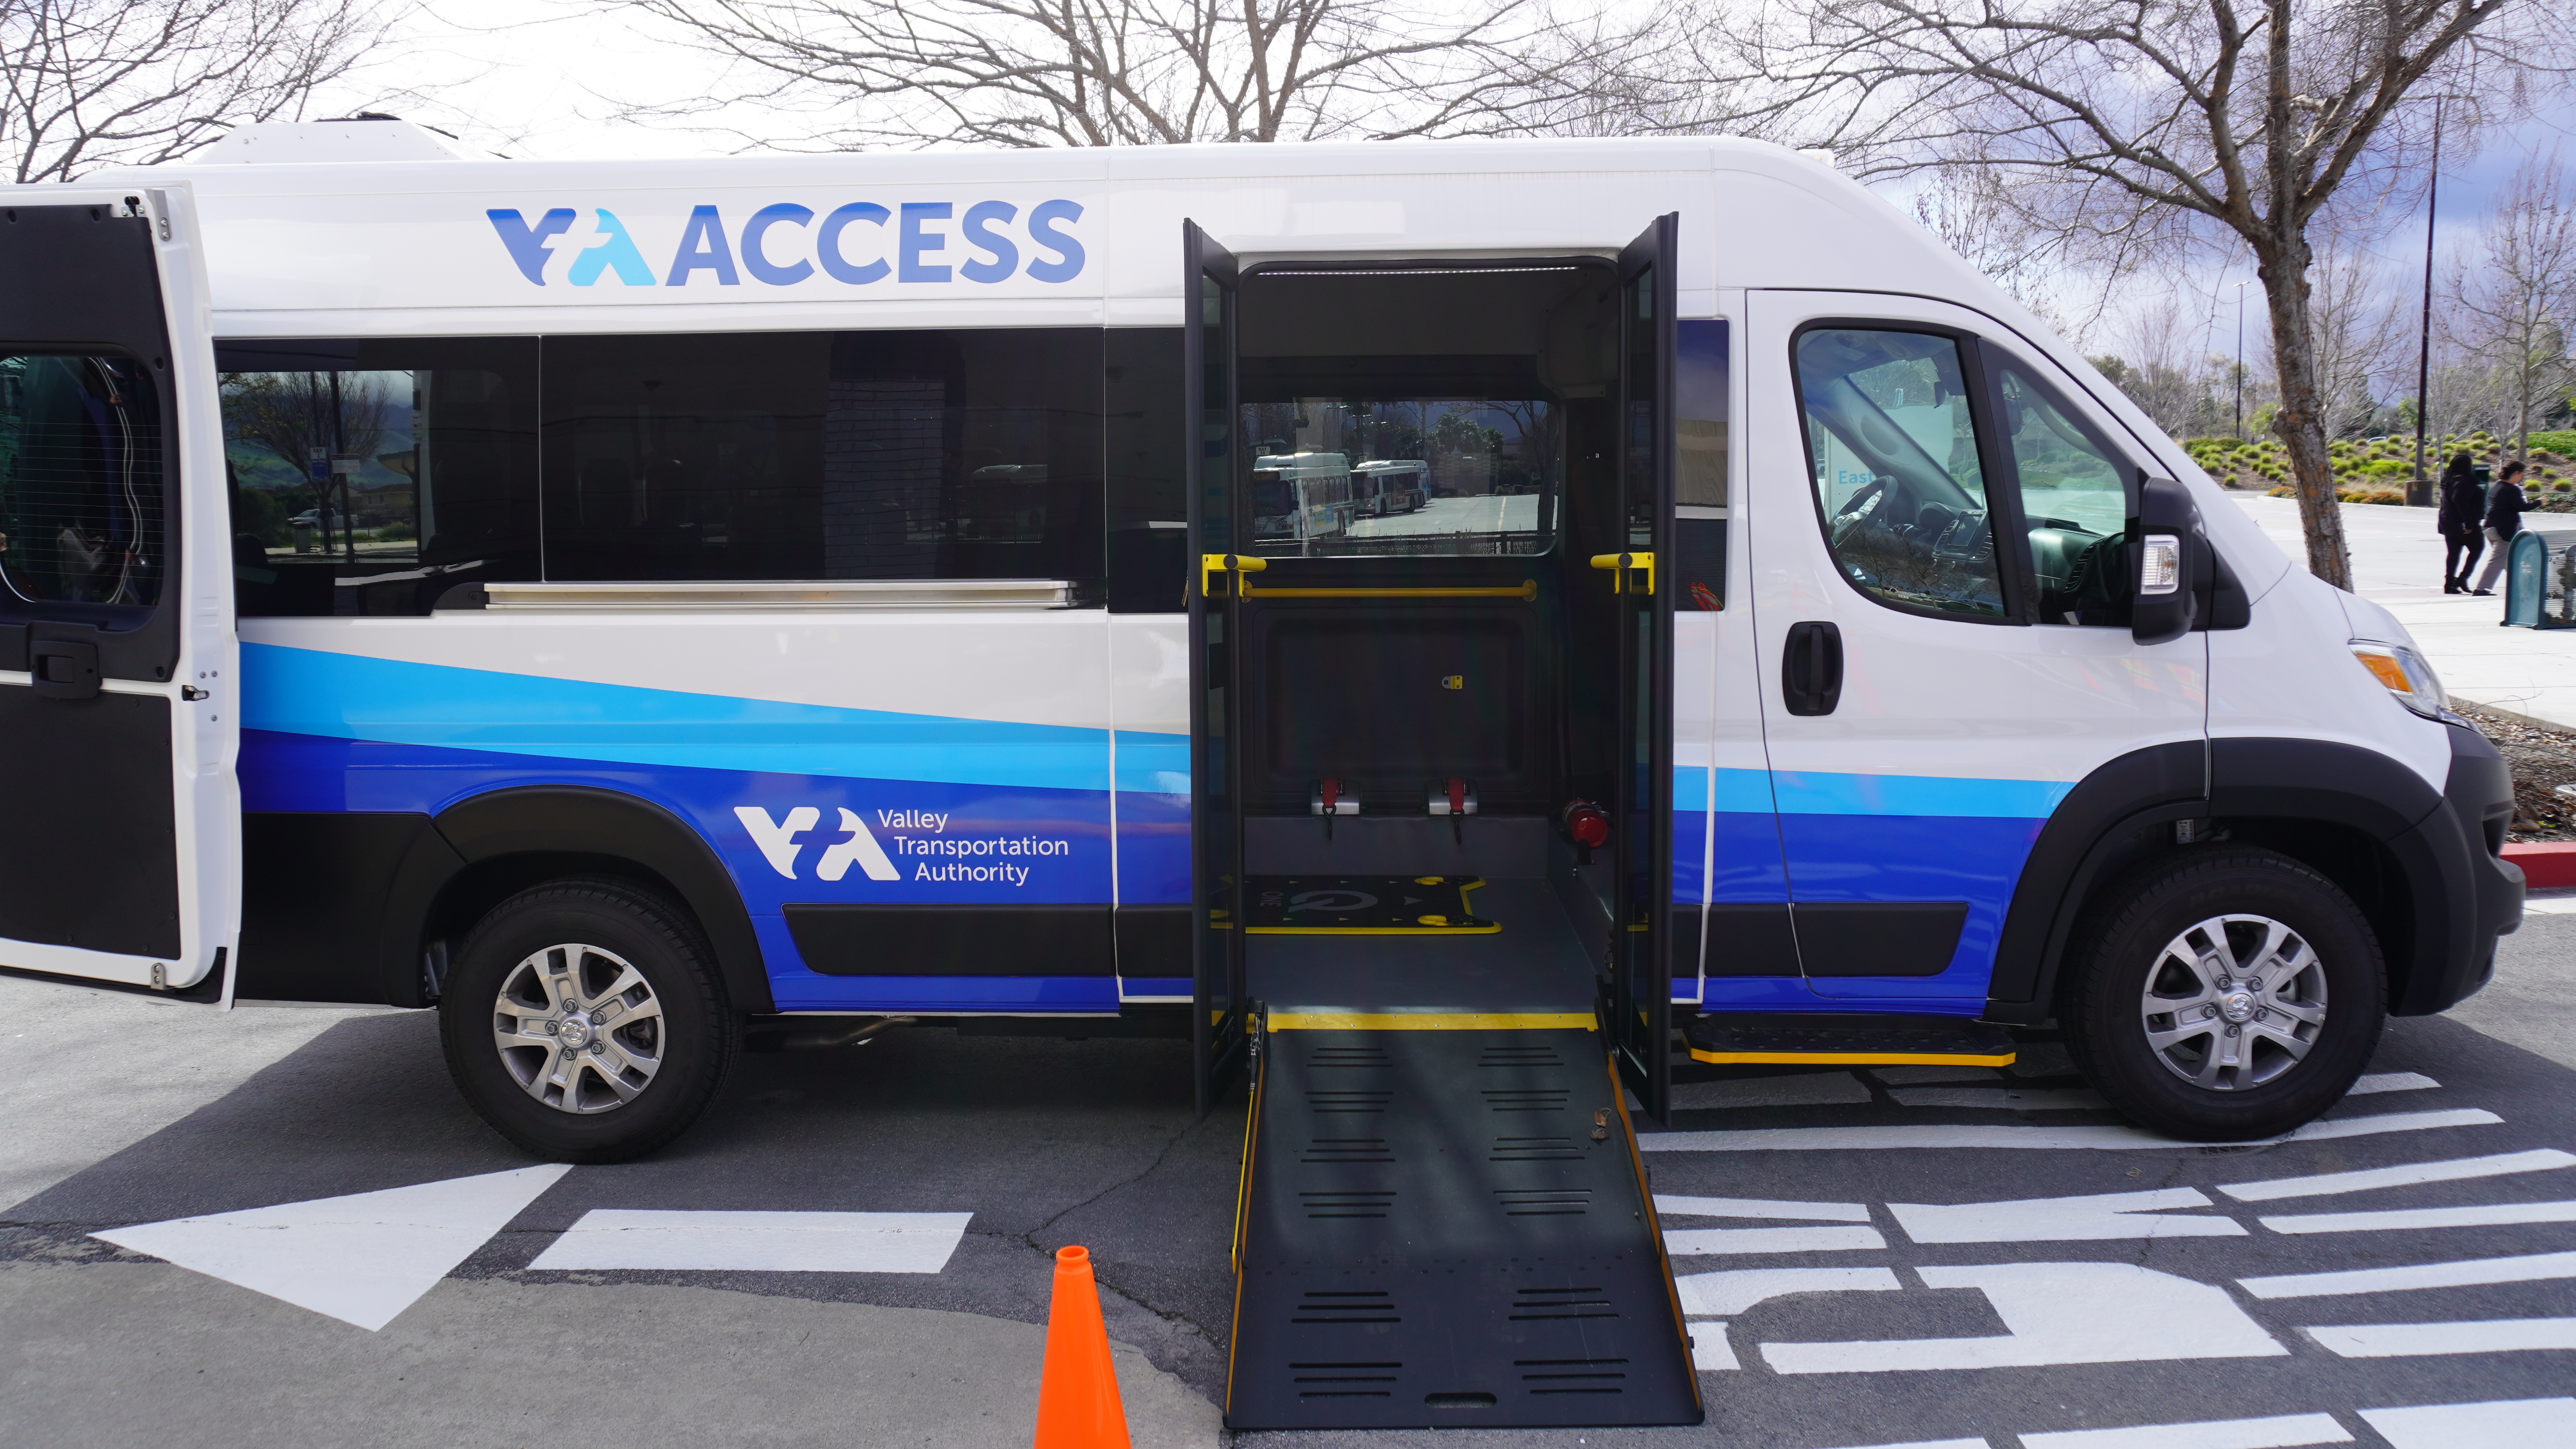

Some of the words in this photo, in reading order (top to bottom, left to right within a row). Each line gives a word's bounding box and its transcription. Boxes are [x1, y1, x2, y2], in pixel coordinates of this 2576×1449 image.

[665, 199, 1085, 285] ACCESS
[1839, 470, 1874, 484] East
[878, 809, 948, 833] Valley
[894, 836, 1069, 859] Transportation
[914, 861, 1029, 886] Authority
[1260, 891, 1284, 906] ONE
